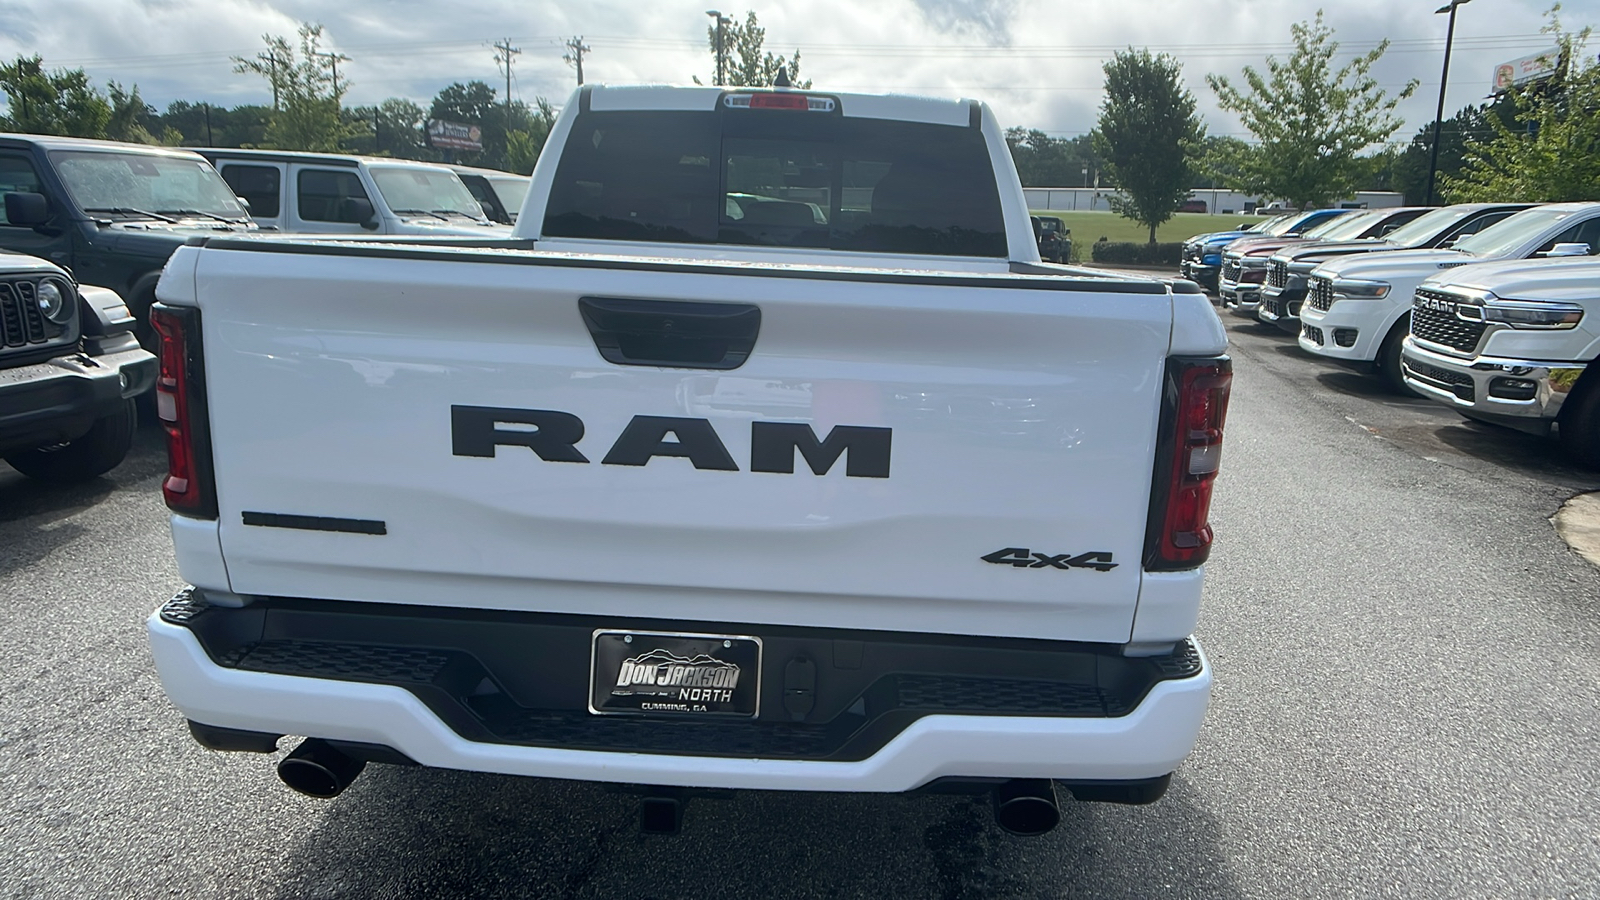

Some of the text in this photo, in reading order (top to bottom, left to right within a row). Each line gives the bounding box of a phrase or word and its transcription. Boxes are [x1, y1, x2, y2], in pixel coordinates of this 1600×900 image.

[451, 404, 893, 478] RAM
[980, 547, 1119, 572] 4x4
[616, 662, 741, 689] DON JACKSON
[641, 702, 708, 712] CUMMING, GA
[678, 688, 733, 702] NORTH
